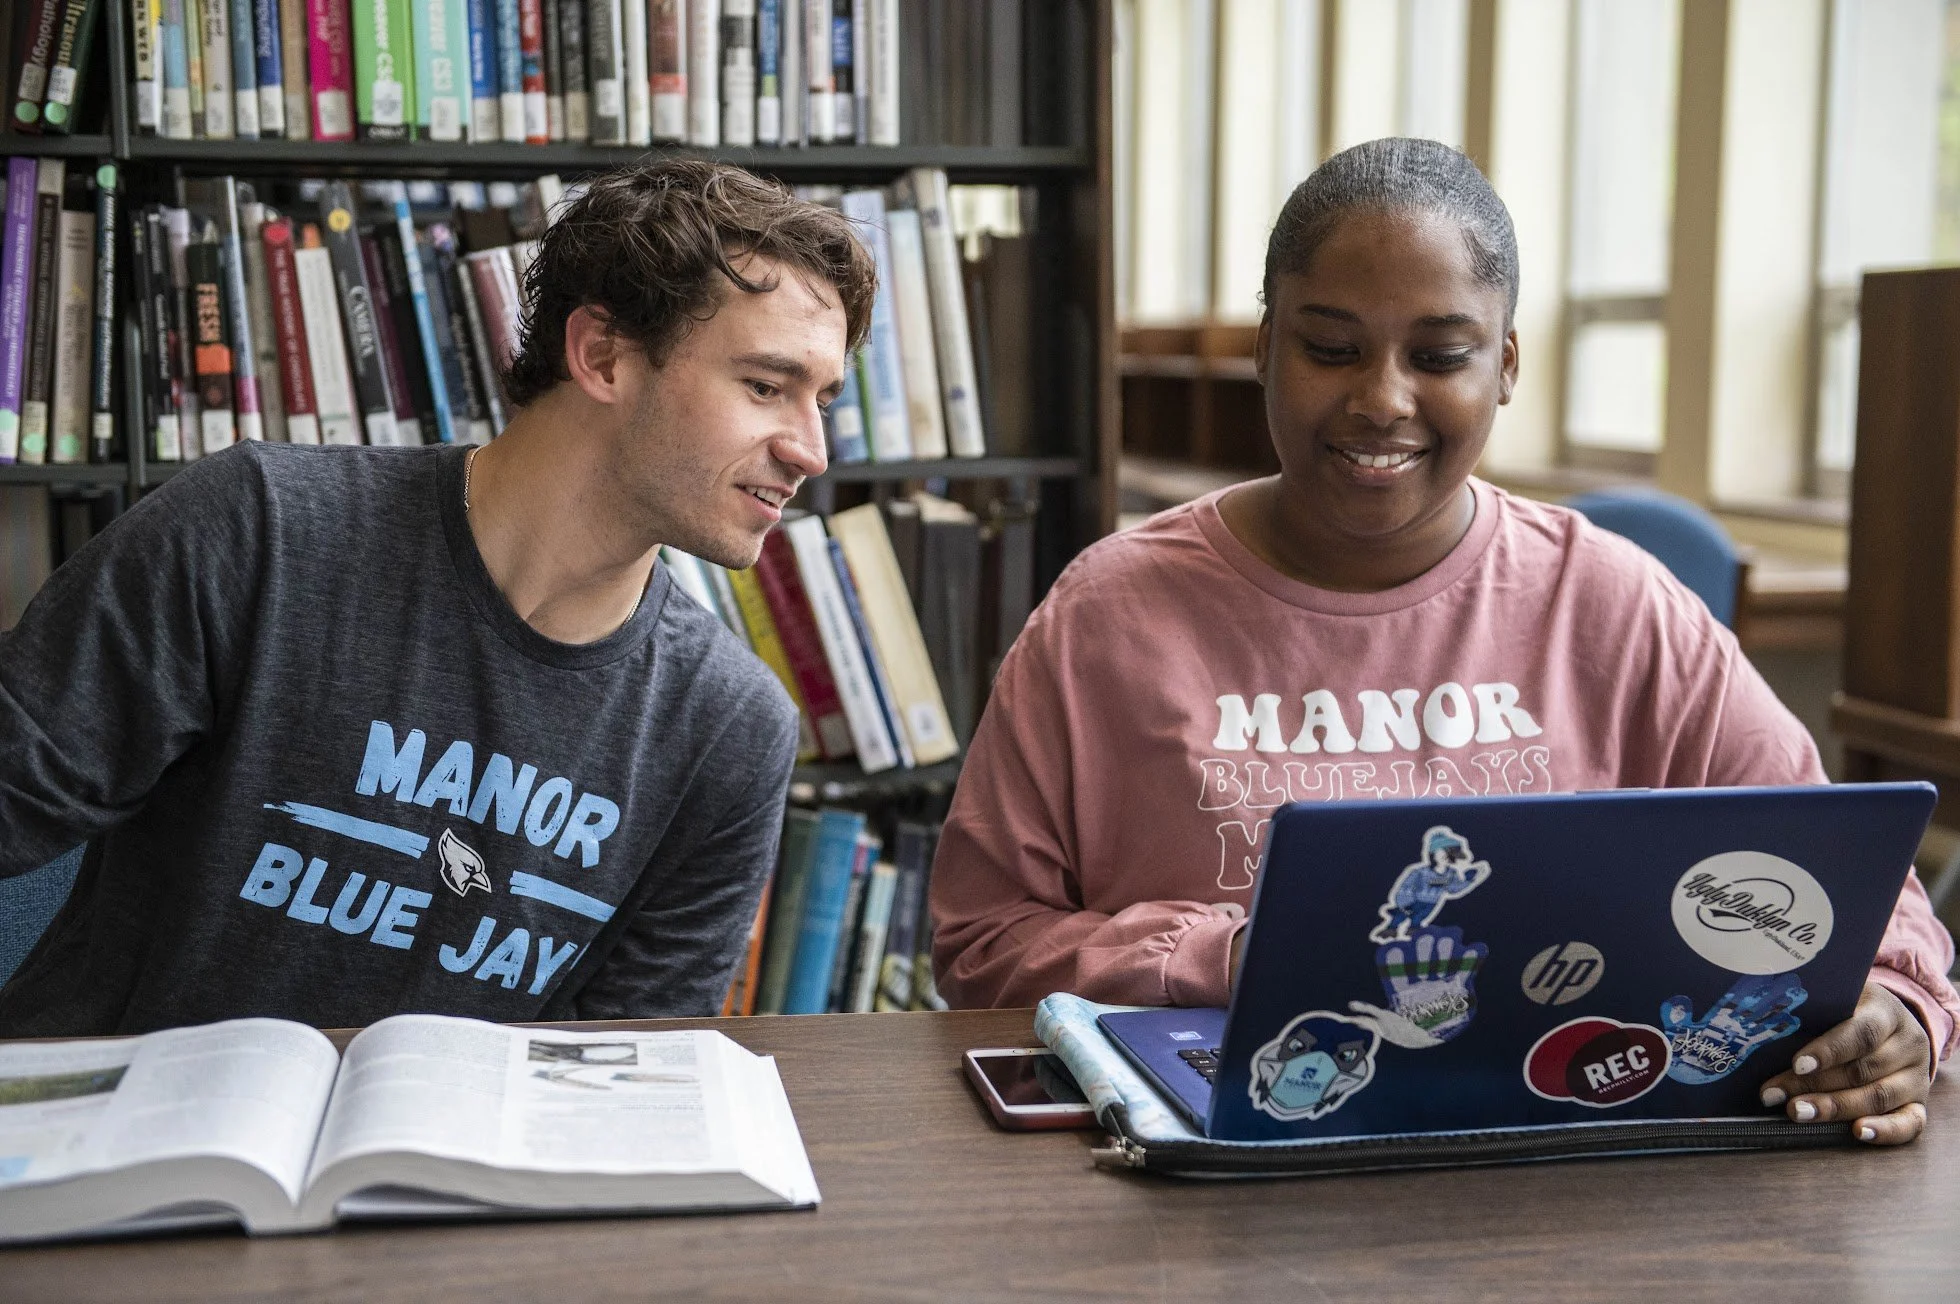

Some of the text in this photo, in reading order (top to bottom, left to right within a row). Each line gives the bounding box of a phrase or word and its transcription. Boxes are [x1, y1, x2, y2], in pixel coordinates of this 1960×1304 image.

[197, 283, 221, 343] FRESH
[1212, 681, 1543, 754] MANOR
[355, 720, 620, 868] MANOR
[1198, 746, 1552, 810] BLUEJAYS
[240, 843, 591, 995] BLUE JAY
[1683, 872, 1732, 905] Ugly
[1720, 891, 1792, 930] Duklyn
[1788, 922, 1817, 945] Co.
[1529, 942, 1598, 1006] hp
[1583, 1045, 1650, 1090] REC
